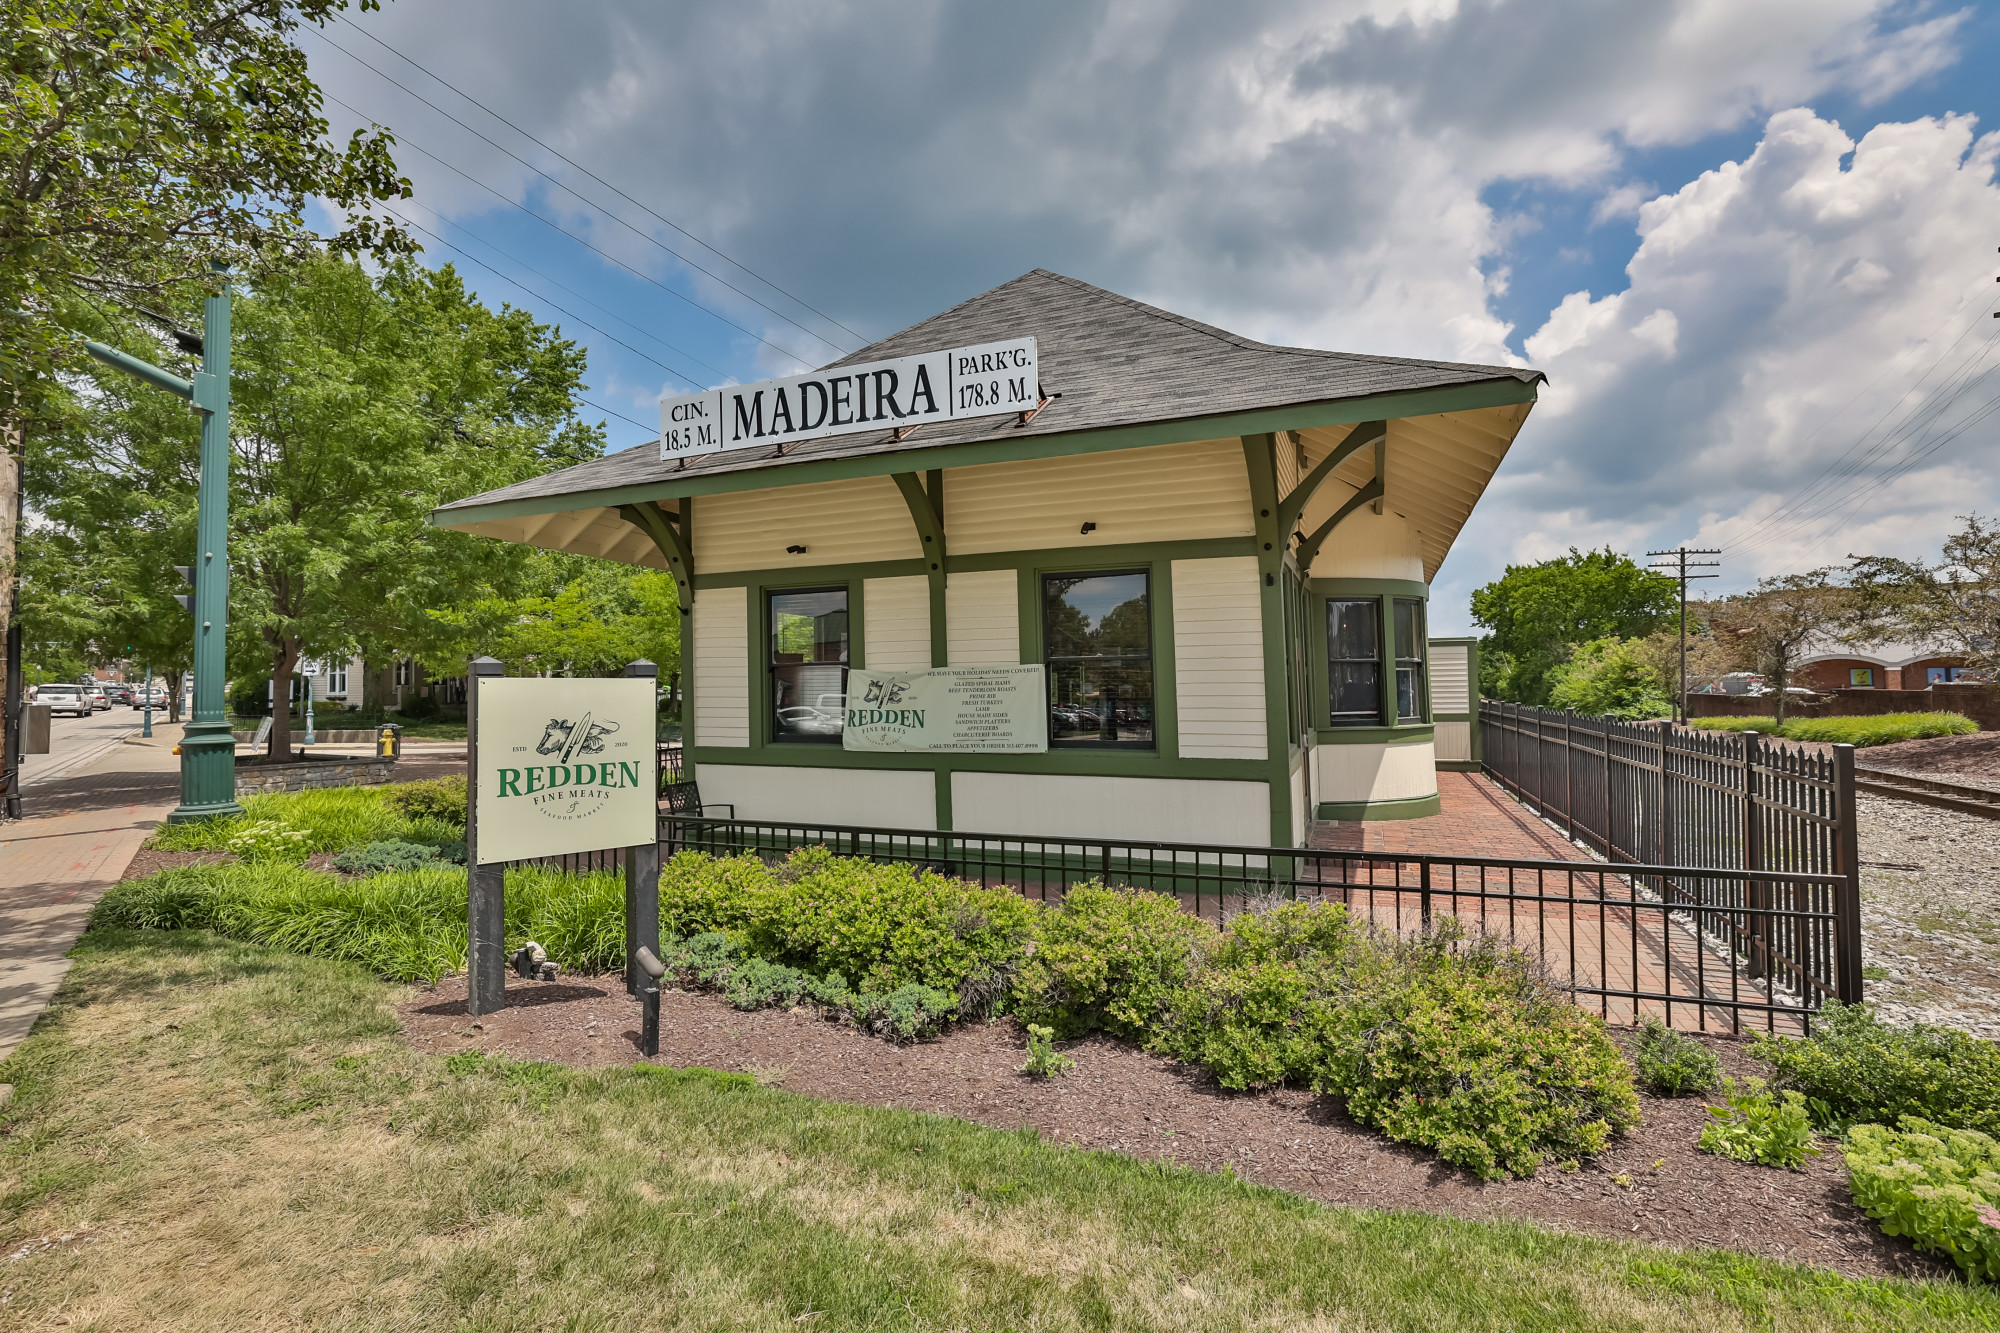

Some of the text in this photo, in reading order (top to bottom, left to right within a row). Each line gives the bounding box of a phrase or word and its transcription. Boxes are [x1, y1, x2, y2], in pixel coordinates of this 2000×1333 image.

[958, 348, 1032, 376] PARK'G.
[732, 364, 940, 441] MADEIRA
[958, 376, 1032, 409] 178.8 M.
[671, 401, 709, 423] CIN.
[664, 424, 717, 451] 18.5 M.
[848, 710, 926, 728] REDDEN
[880, 726, 906, 734] MEATS
[496, 761, 640, 798] REDDEN
[533, 790, 610, 805] FINE MEATS
[540, 802, 604, 820] SEAFOOD MARKET
